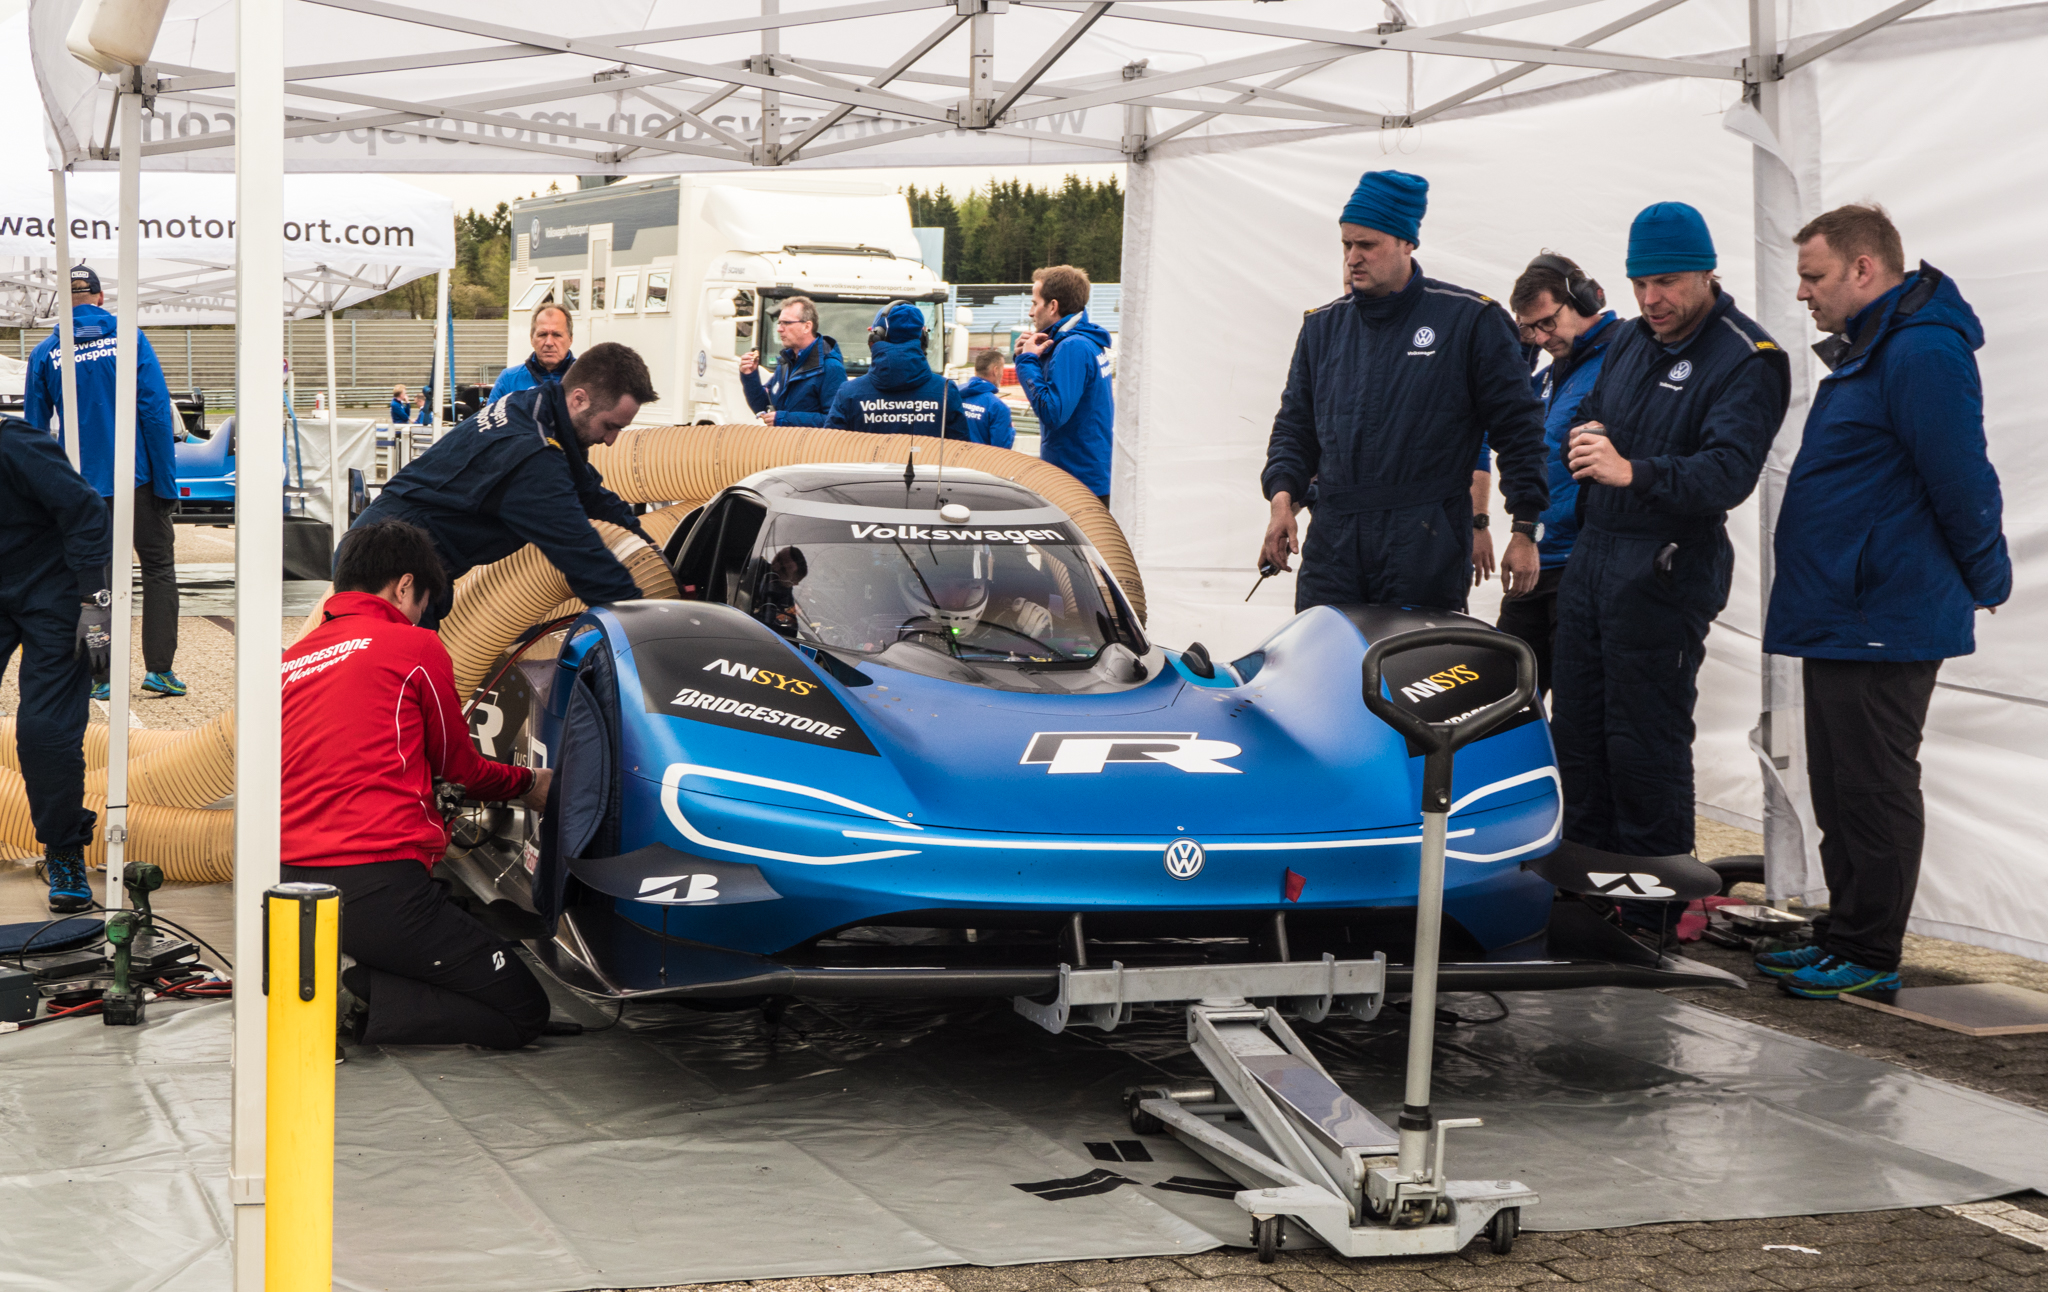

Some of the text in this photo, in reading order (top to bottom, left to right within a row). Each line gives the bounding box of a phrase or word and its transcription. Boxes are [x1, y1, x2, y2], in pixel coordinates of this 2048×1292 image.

[813, 282, 916, 292] www.volkswagen-motorsport.com
[49, 337, 118, 360] Voswagen
[53, 347, 118, 370] Morsport
[860, 399, 939, 412] Volkswagen
[863, 412, 936, 425] Motorsport
[850, 523, 1066, 545] Volkswagen
[702, 658, 814, 696] ANSYS
[1400, 664, 1480, 703] ANSYS
[670, 688, 846, 740] BRIDGESTONE
